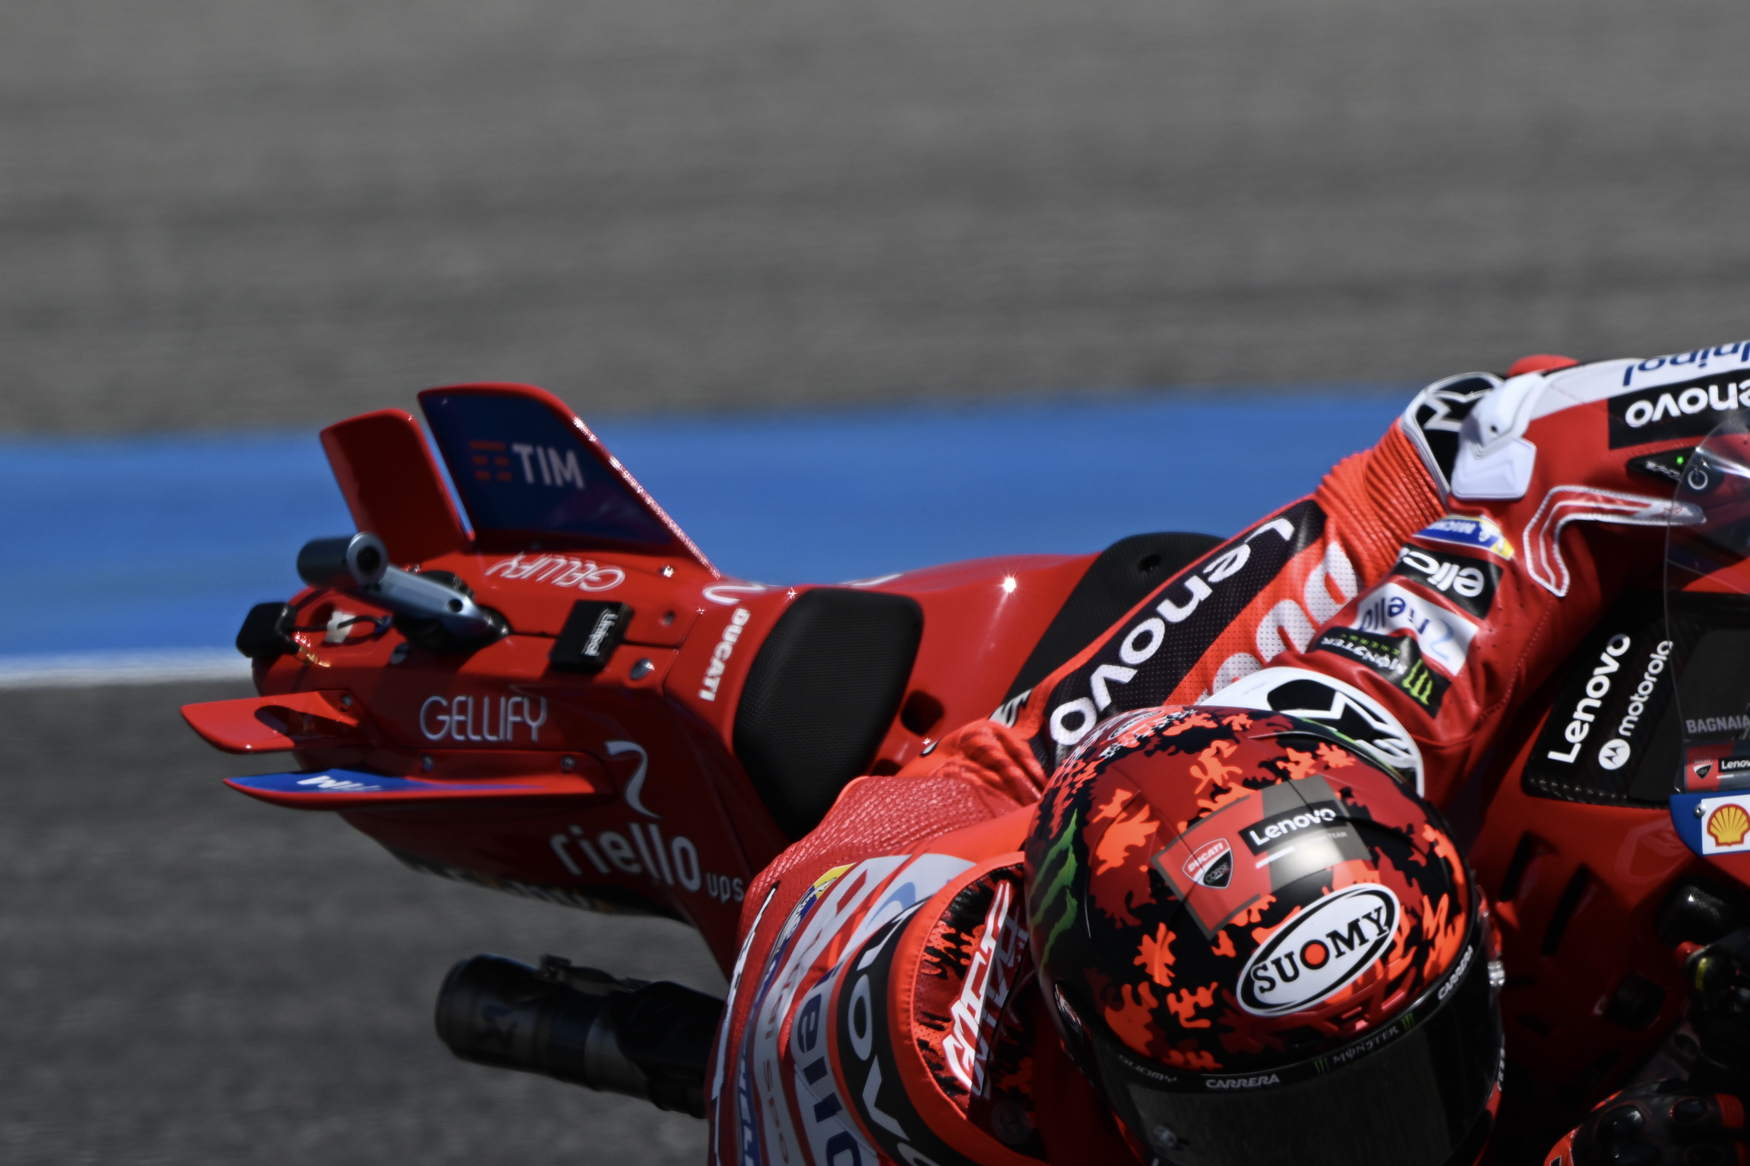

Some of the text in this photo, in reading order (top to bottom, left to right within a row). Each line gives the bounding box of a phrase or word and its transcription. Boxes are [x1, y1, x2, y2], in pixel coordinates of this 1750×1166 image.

[513, 443, 585, 490] TIM
[698, 608, 750, 701] DUCATI
[1049, 517, 1295, 746] Lenovo
[420, 696, 547, 742] GELLIFY
[1548, 633, 1632, 765] Lenovo
[1618, 639, 1675, 738] motorola
[1187, 842, 1225, 873] DUCATI
[1250, 808, 1337, 846] Lenovo
[549, 821, 701, 891] riello
[706, 873, 744, 904] ups
[1206, 862, 1230, 884] CORSE
[1251, 906, 1392, 994] SUOMY
[1205, 1074, 1280, 1090] CARRERA
